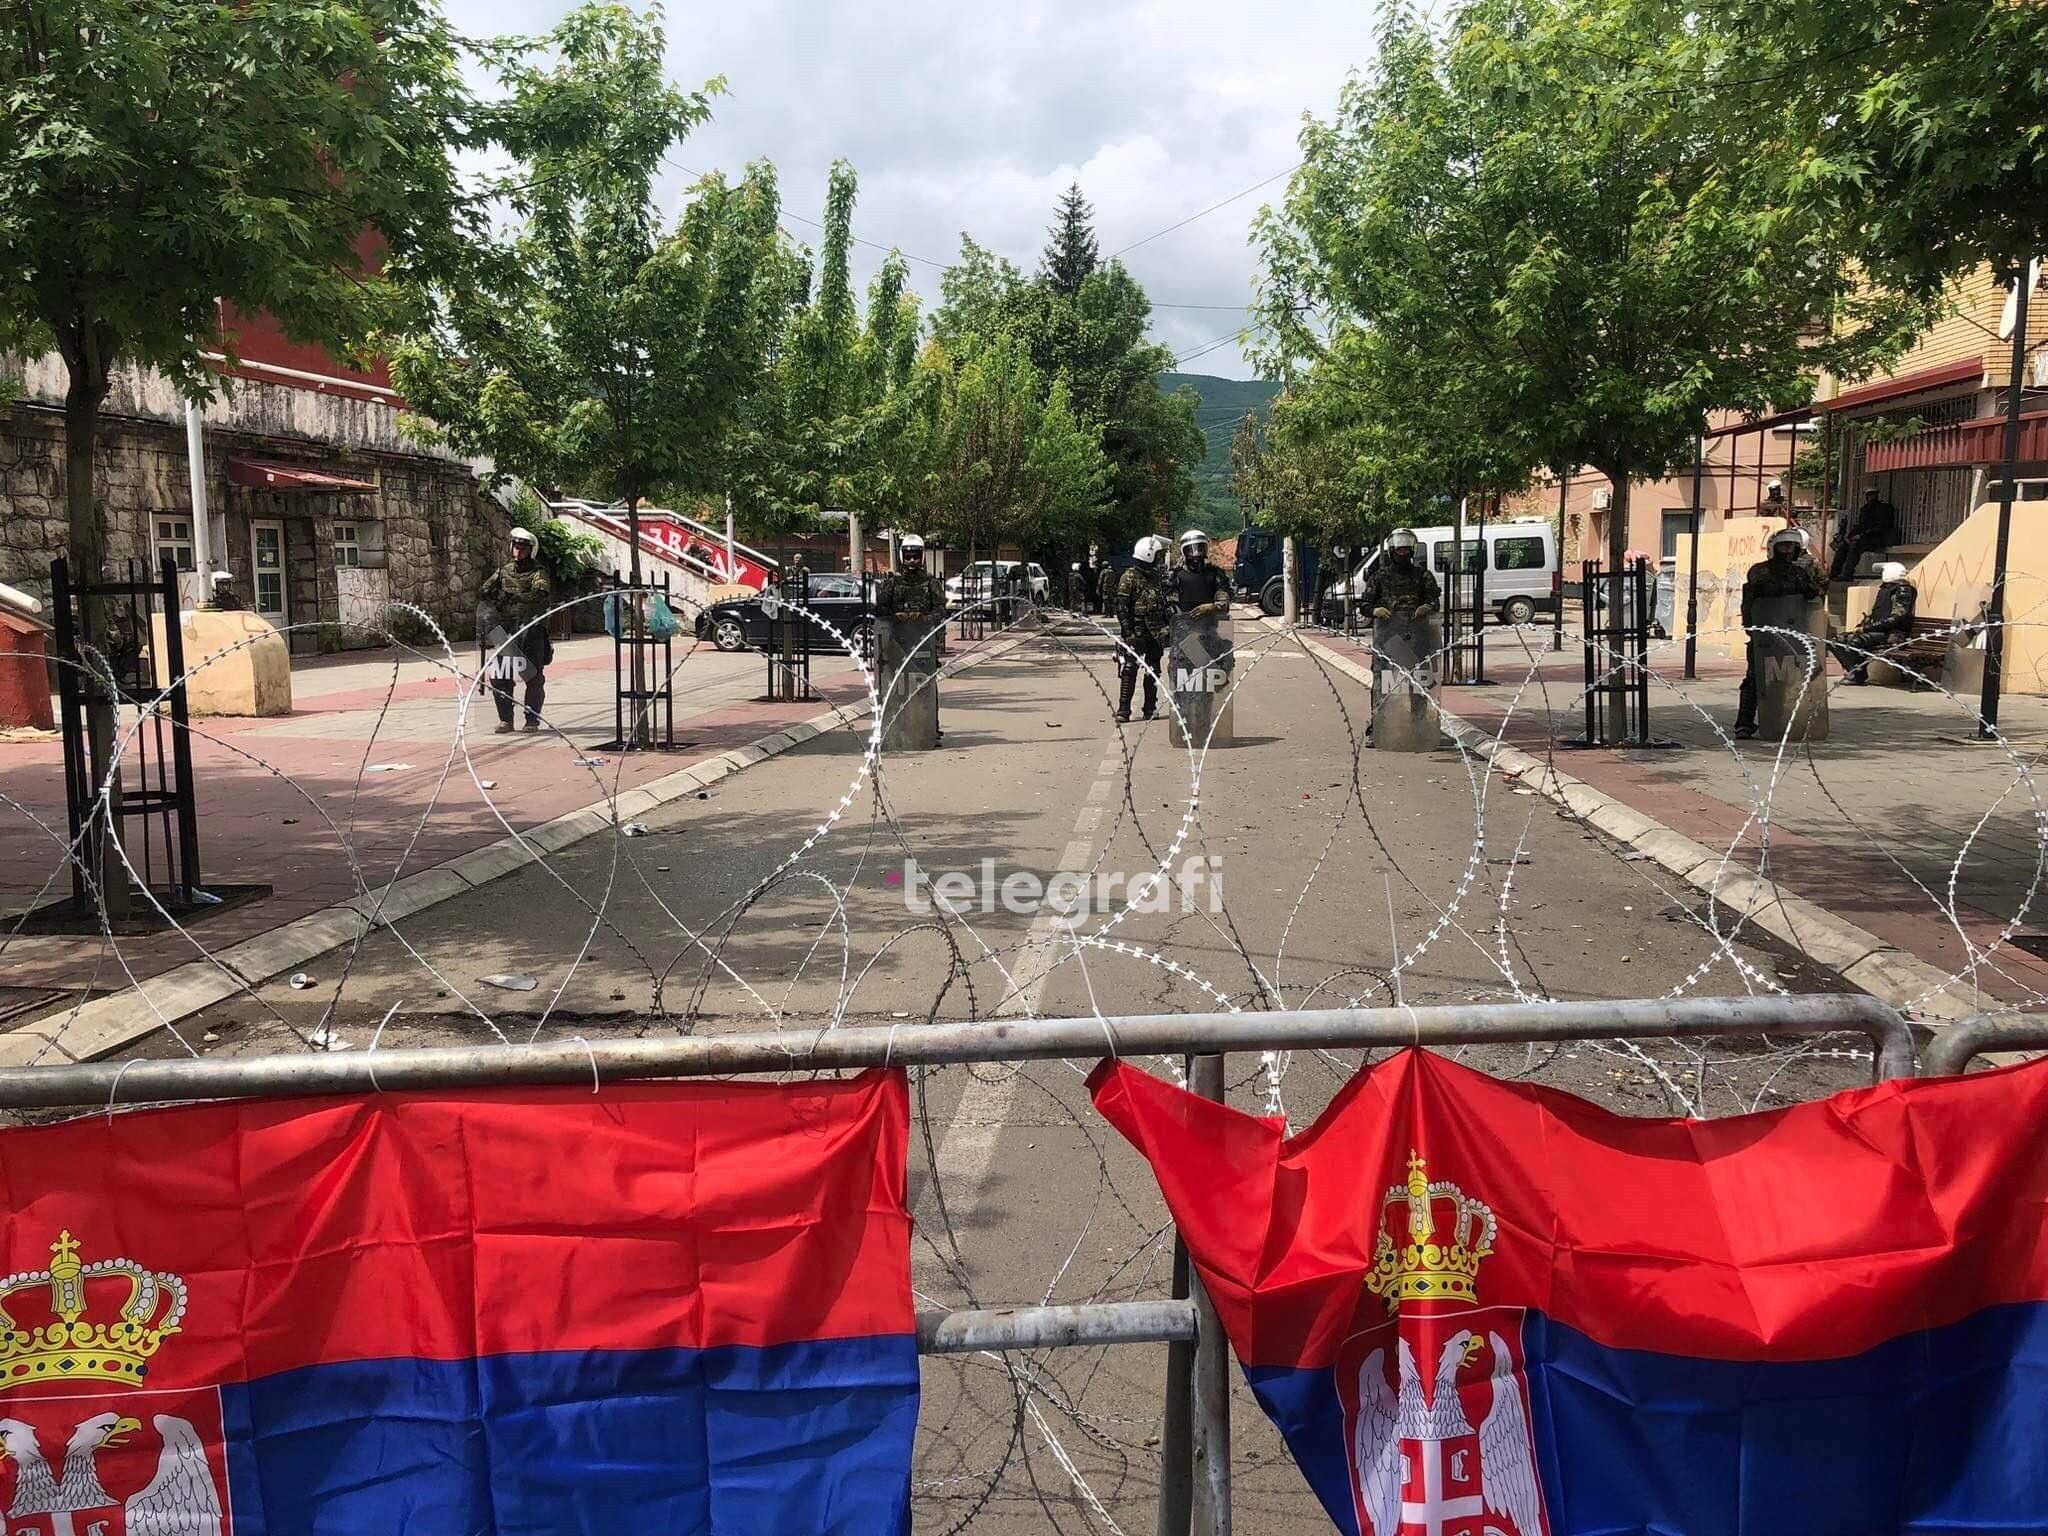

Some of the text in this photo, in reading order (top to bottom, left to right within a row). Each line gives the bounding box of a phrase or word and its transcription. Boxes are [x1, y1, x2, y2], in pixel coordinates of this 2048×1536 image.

[489, 655, 527, 680] MP
[1764, 655, 1810, 681] M
[881, 672, 929, 695] MP
[1177, 668, 1226, 692] MP
[1381, 670, 1434, 694] MP
